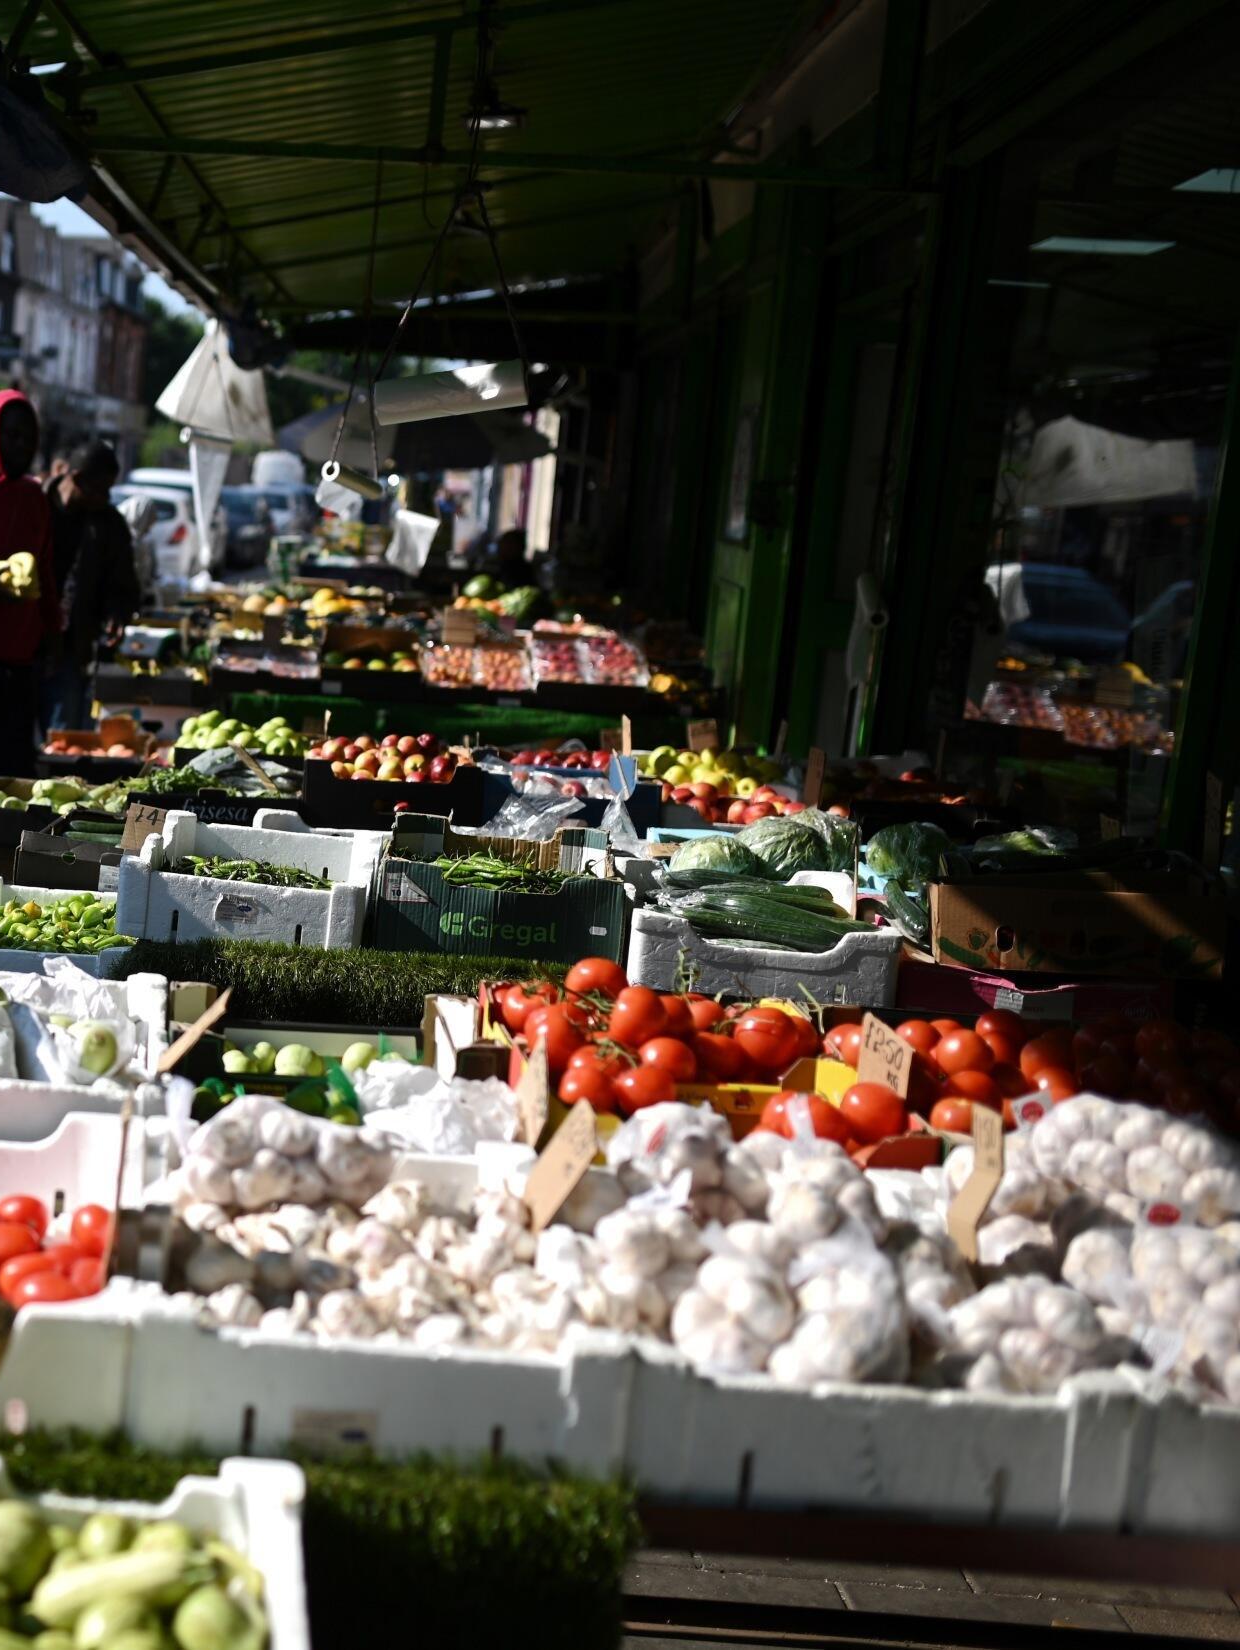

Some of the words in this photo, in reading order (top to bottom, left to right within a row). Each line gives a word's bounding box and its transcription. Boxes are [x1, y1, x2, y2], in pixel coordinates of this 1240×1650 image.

[134, 806, 167, 826] £4
[391, 889, 402, 897] 10
[468, 915, 558, 947] Gregal
